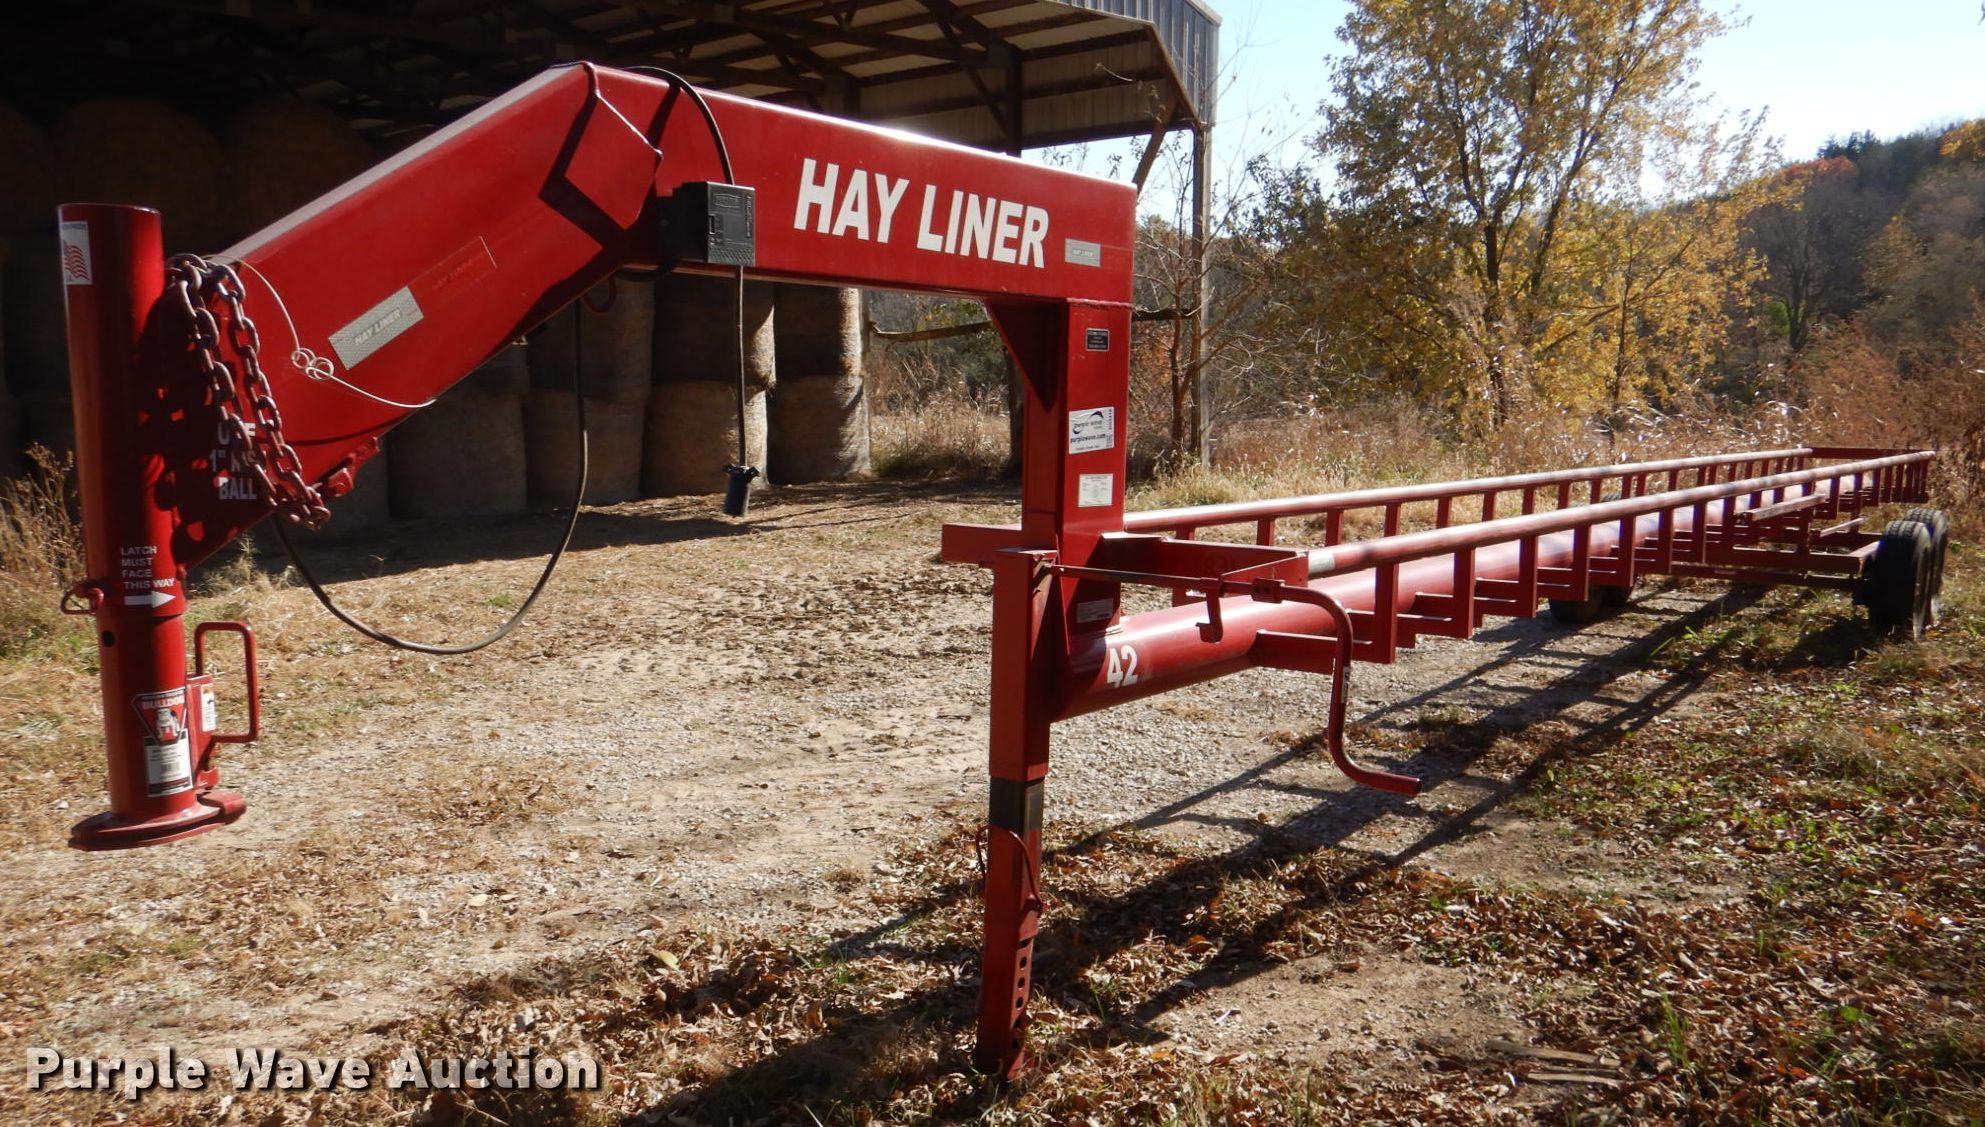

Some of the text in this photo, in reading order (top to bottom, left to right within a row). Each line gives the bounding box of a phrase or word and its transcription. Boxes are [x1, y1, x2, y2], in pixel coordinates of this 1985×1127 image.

[793, 158, 910, 243] HAY
[916, 184, 1049, 269] LINER
[354, 308, 402, 346] HAY LINER
[218, 421, 256, 445] UE
[219, 476, 257, 500] BALL
[120, 546, 157, 555] LATCH
[121, 557, 153, 567] MUST
[122, 569, 152, 578] FACE
[122, 577, 175, 589] THIS WAY
[1106, 644, 1138, 688] 42
